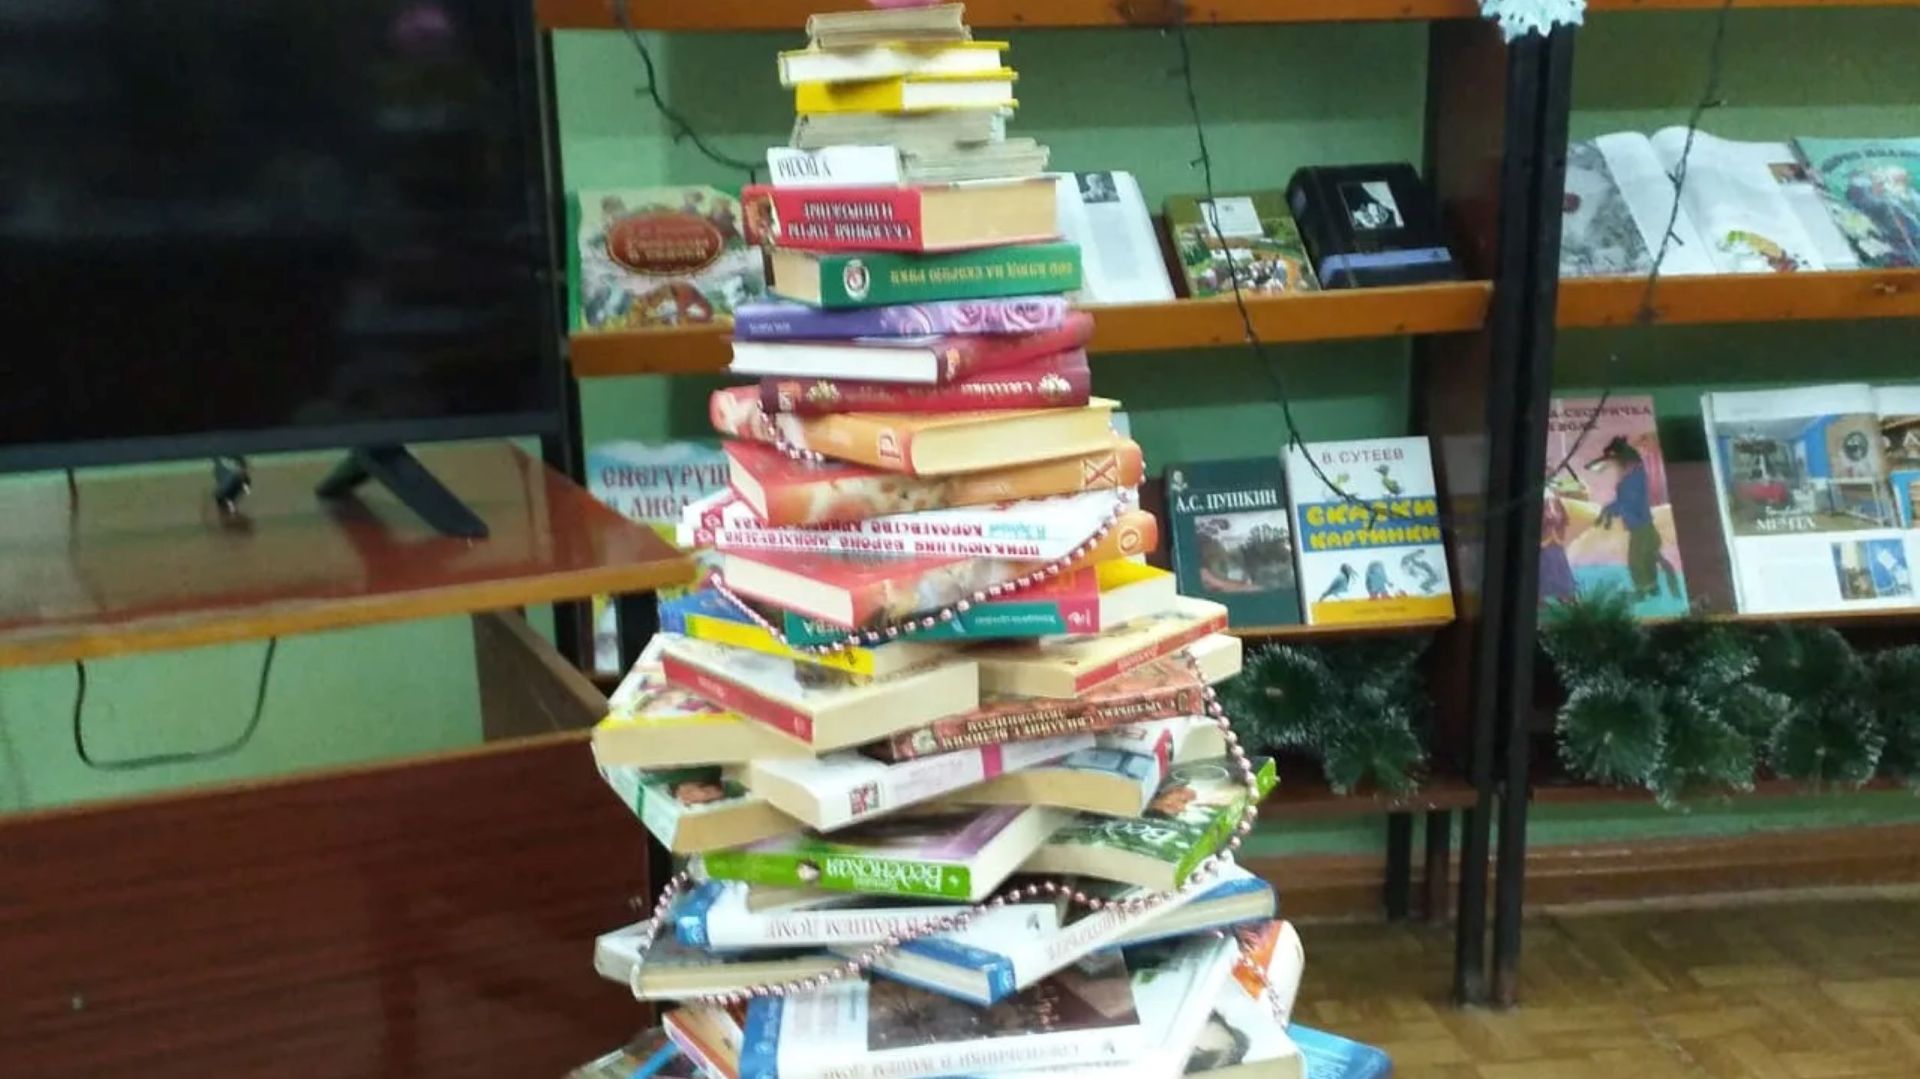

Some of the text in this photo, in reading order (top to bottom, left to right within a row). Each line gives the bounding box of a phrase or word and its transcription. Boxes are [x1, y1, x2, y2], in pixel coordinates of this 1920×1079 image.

[788, 221, 912, 243] СКАЗОЧНЫЕ ТОРТЫ
[986, 263, 1004, 279] НА
[1322, 448, 1404, 464] В. СУТЕЕВ
[1175, 489, 1278, 513] А.С. ПУШКИН
[1307, 500, 1437, 526] СКАЗКИ
[871, 519, 983, 537] КОРОЛЕВСТВО
[1310, 525, 1442, 550] КАРТИНКИ
[725, 531, 1040, 556] ПРИКЛЮЧЕНИЯ БАРОНА МЮНХГАУЗЕНА
[942, 727, 1009, 749] ВЕЛИКИМ
[769, 916, 815, 939] ДОМЕ
